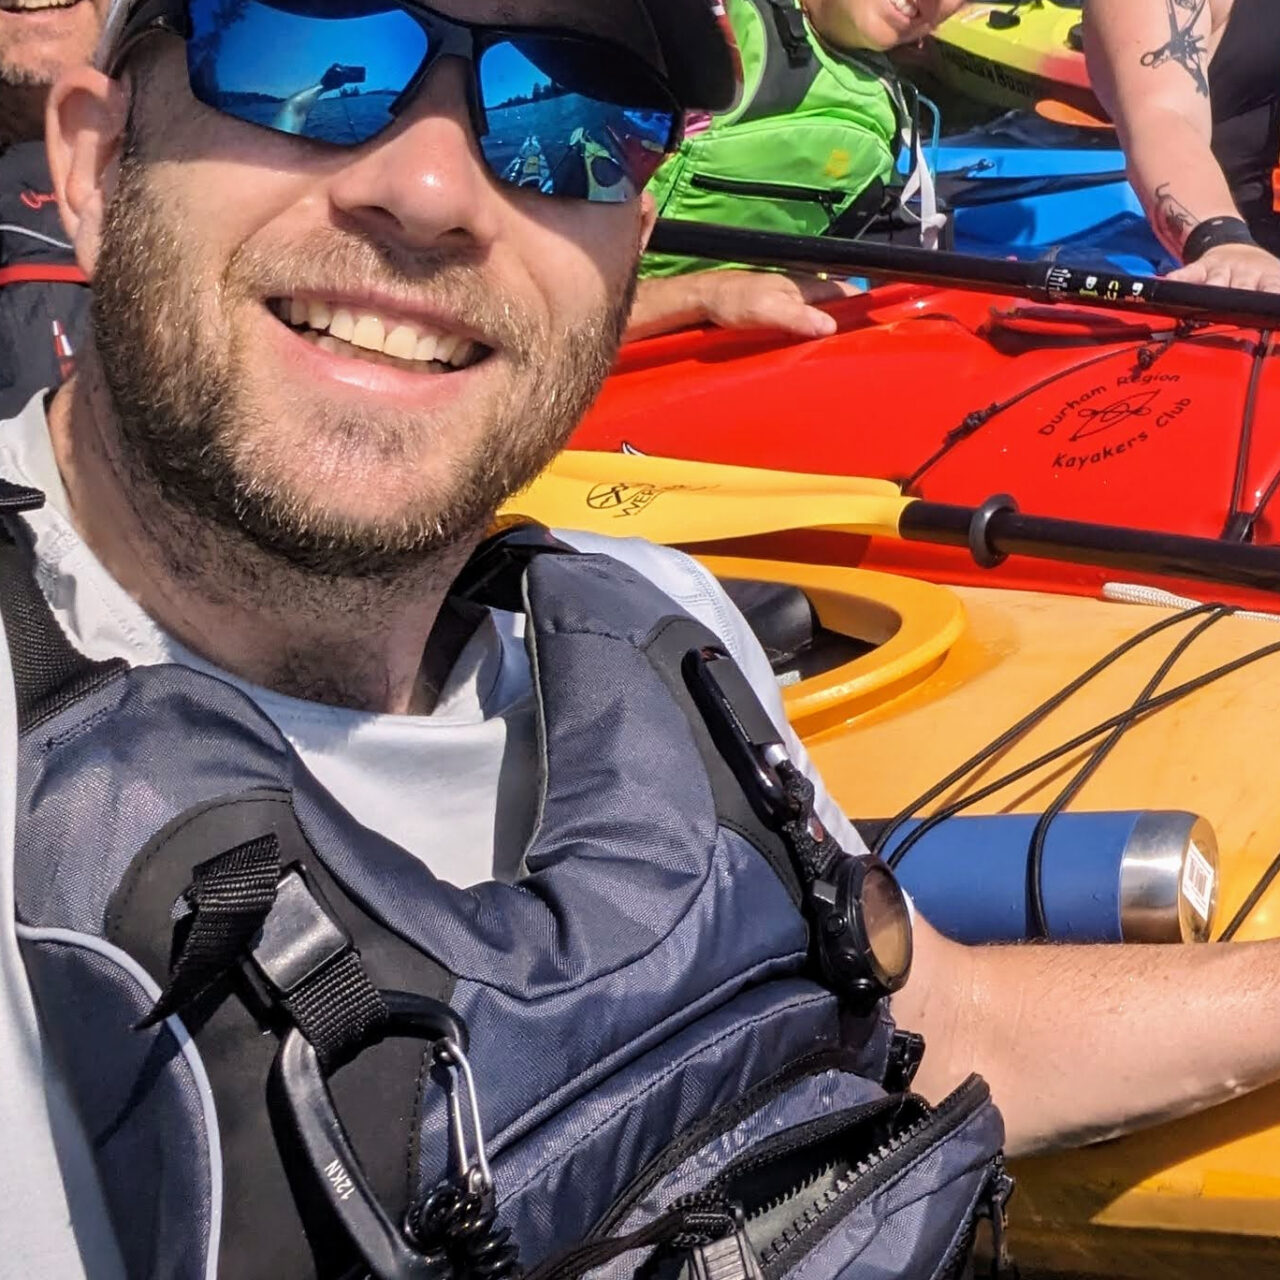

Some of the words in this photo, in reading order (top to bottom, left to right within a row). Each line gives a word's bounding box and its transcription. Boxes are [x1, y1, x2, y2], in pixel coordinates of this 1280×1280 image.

[1038, 385, 1107, 436] Durham
[1116, 373, 1181, 387] Region
[1051, 431, 1149, 471] Kayakers
[1155, 397, 1192, 429] Club
[324, 1158, 356, 1200] 12KN
